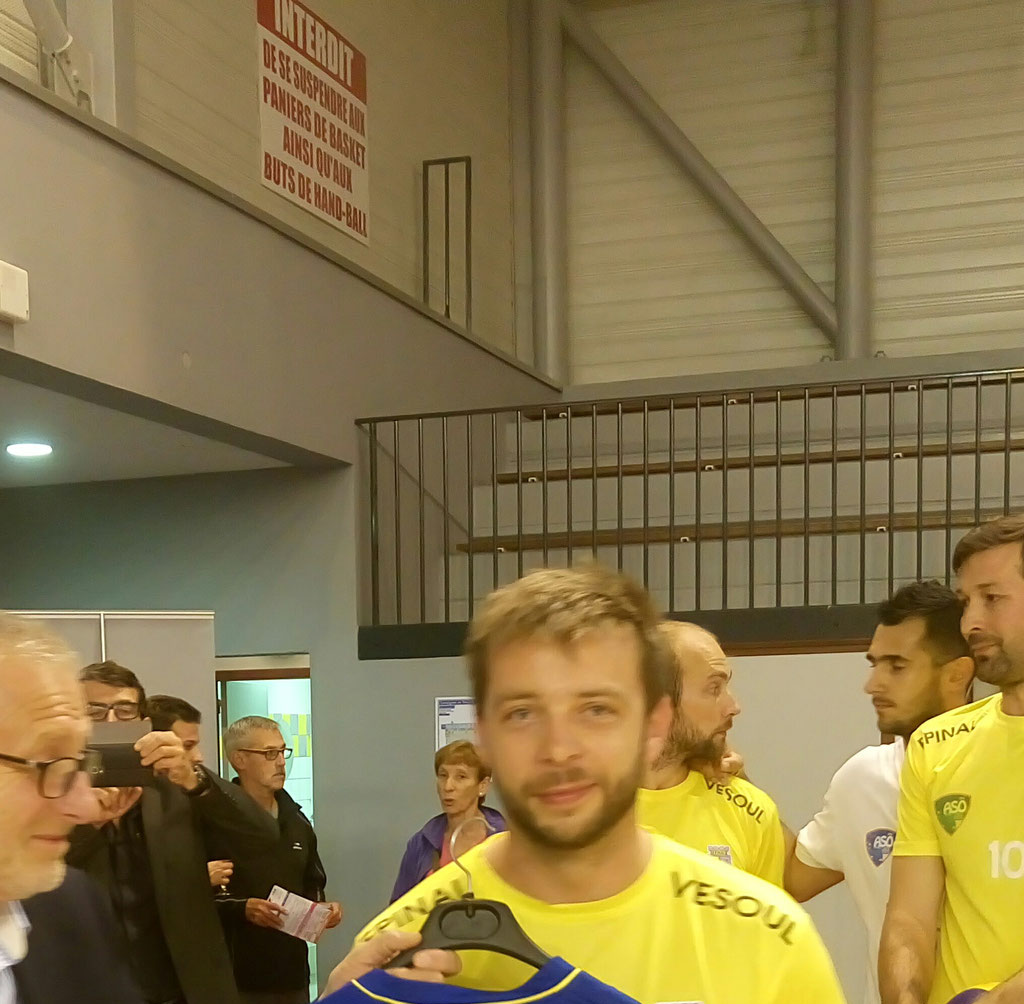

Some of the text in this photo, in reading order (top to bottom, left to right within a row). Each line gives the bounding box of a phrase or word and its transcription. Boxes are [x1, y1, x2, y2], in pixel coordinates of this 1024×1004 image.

[275, 0, 354, 87] INTERDIT
[263, 38, 365, 138] DE SE SUSPENDRE AUX
[263, 75, 366, 170] PANIERS DE BASKET
[264, 151, 368, 238] BUTS DE HAND-BALL
[283, 125, 353, 194] AINSI QU'AUX
[706, 779, 765, 824] VESOUL
[988, 840, 1024, 879] 10
[669, 871, 796, 946] VESOUL
